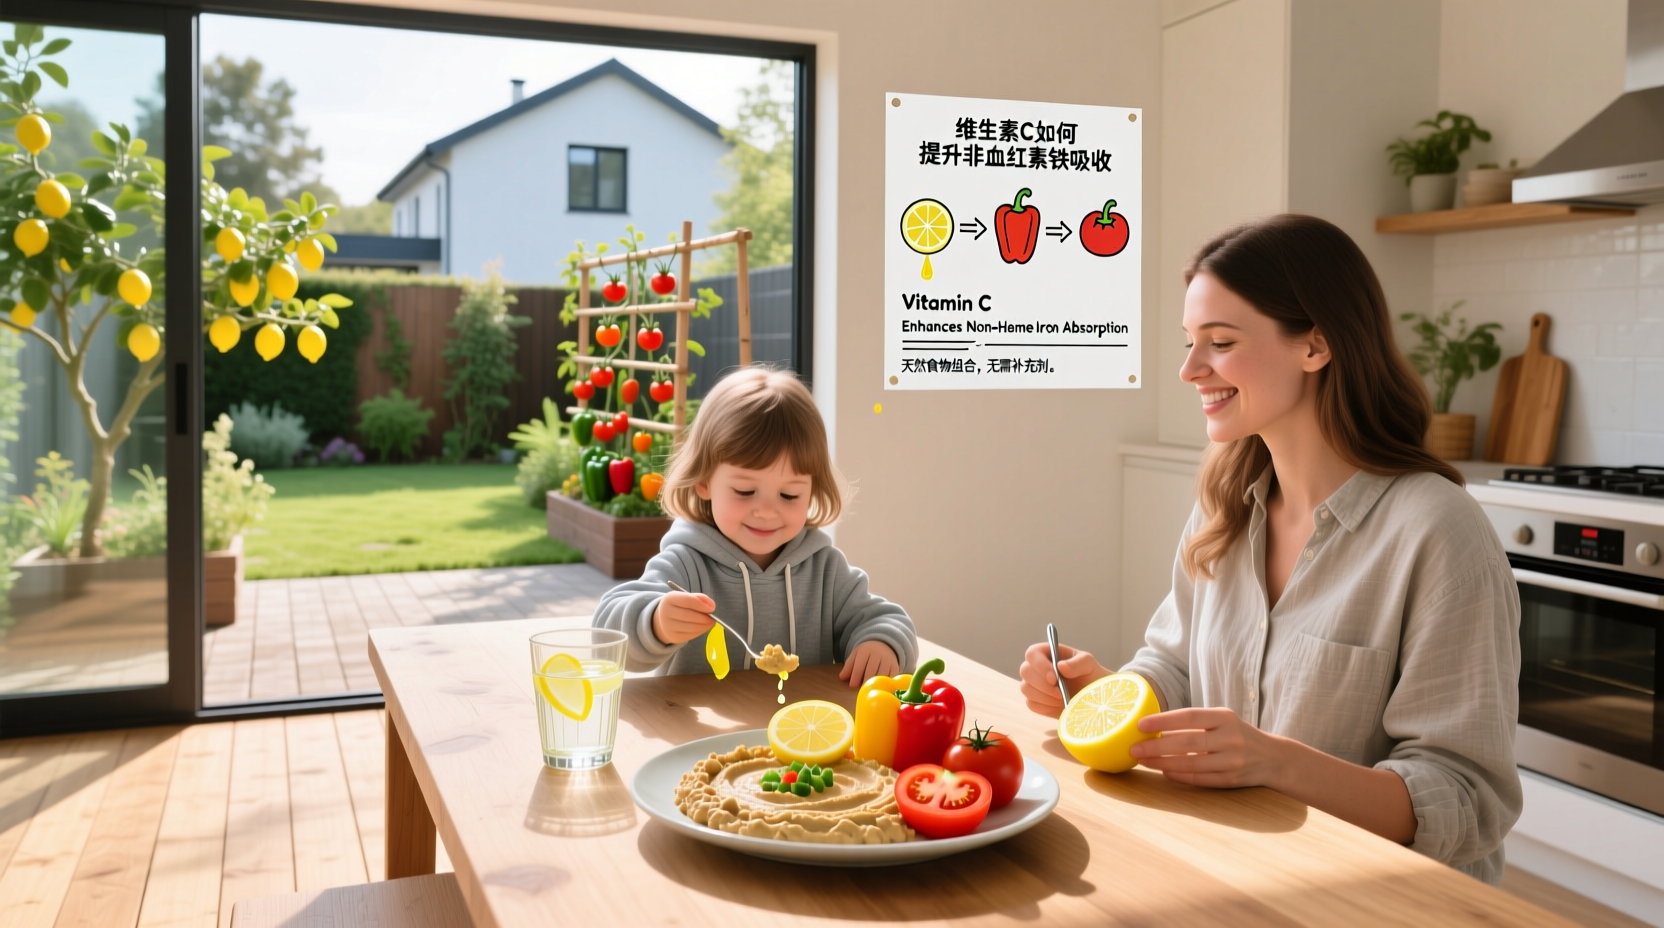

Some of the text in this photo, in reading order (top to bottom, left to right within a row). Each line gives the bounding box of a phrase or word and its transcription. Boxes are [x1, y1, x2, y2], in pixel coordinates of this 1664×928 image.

[955, 116, 1079, 145] 维生素C如何
[918, 140, 1113, 173] 提升非血红素铁吸收
[901, 292, 992, 312] Vitamin C
[901, 319, 1129, 339] Enhances Non-Heme Iron Absorption
